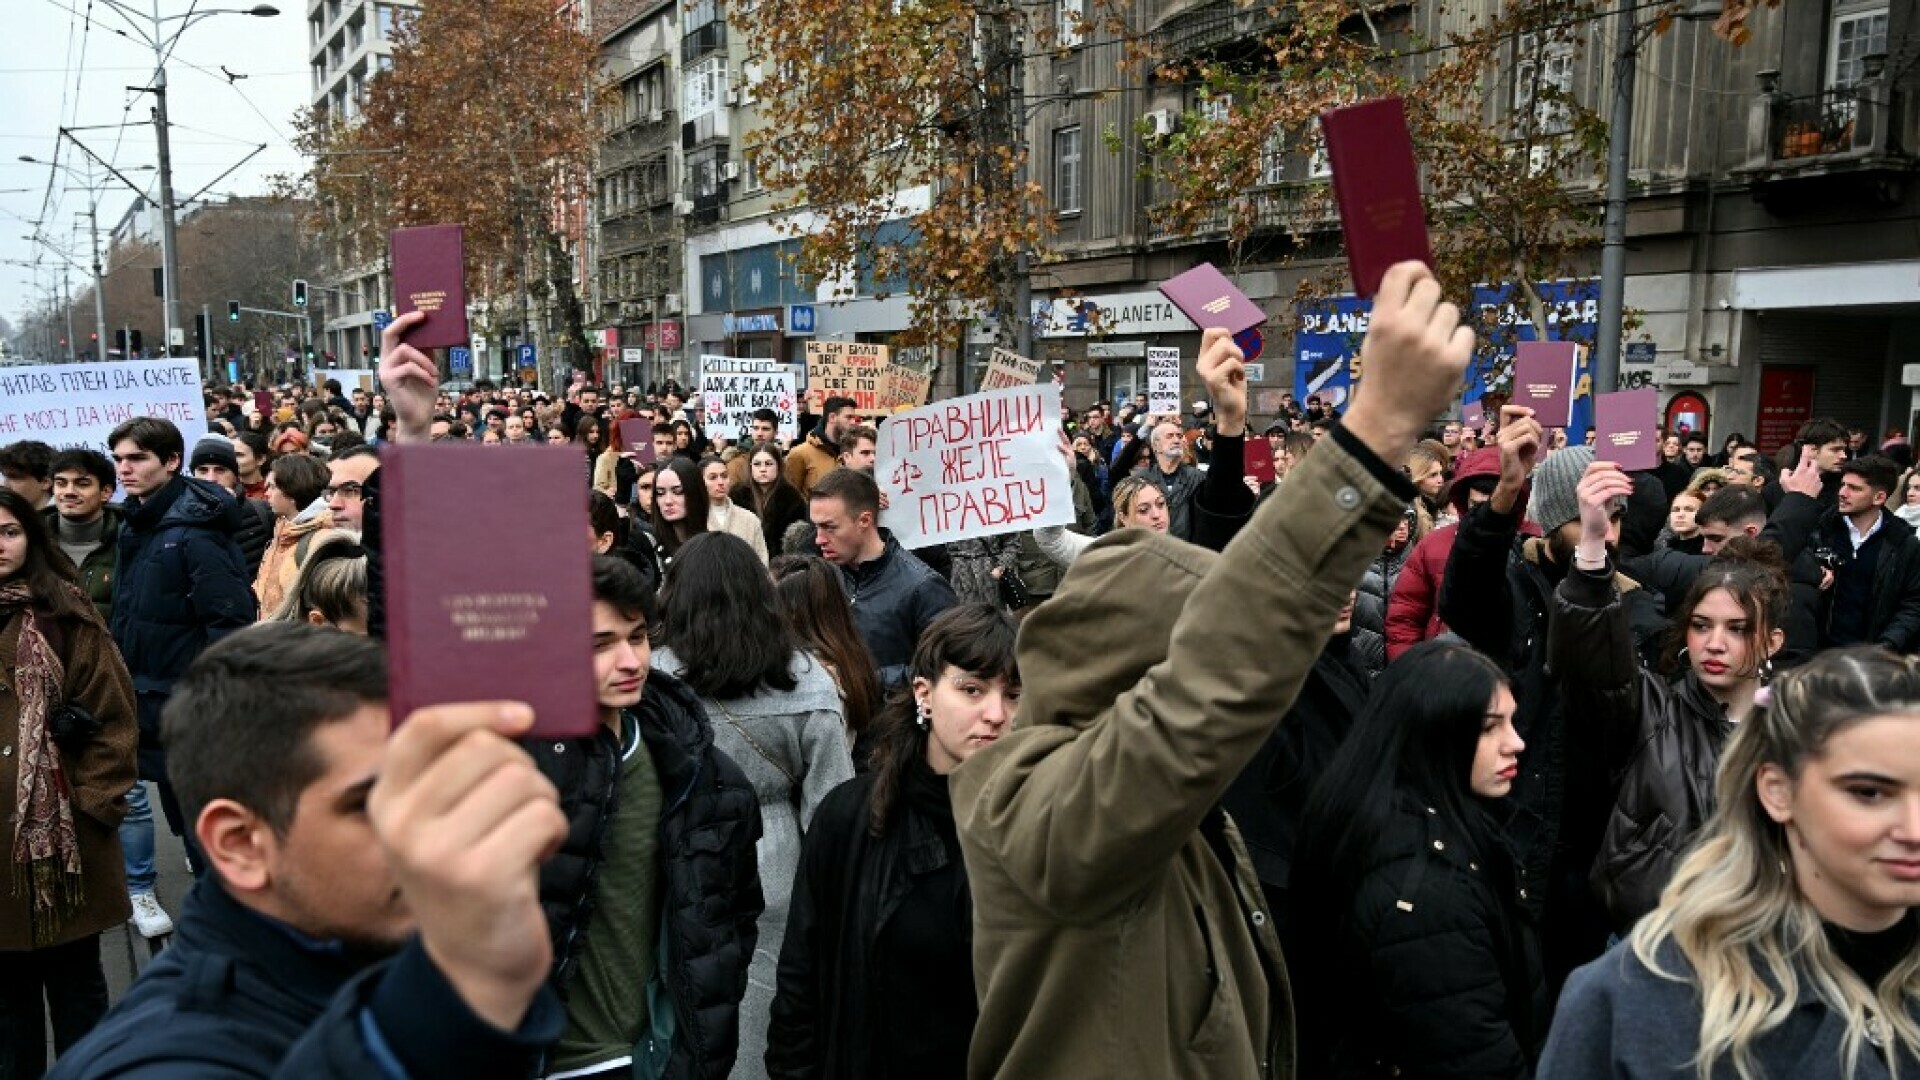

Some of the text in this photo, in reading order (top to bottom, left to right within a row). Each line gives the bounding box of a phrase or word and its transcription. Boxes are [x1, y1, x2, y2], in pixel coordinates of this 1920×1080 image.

[1103, 303, 1173, 323] PLANETA
[522, 347, 532, 361] P
[808, 342, 821, 353] НЕ
[849, 344, 878, 356] БИЛО
[818, 354, 876, 367] ОВЕ КРВИ
[60, 371, 108, 393] ПЛЕН
[114, 369, 139, 390] ДА
[143, 367, 196, 387] СКУПЕ
[809, 365, 831, 378] ДА
[840, 366, 853, 378] ЈЕ
[825, 379, 848, 389] СВЕ
[857, 379, 875, 391] ПО
[75, 405, 101, 428] ДА
[890, 394, 1044, 457] ПРАВНИЦИ
[941, 438, 1016, 485] ЖЕЛЕ
[918, 477, 1048, 535] ПРАВДУ
